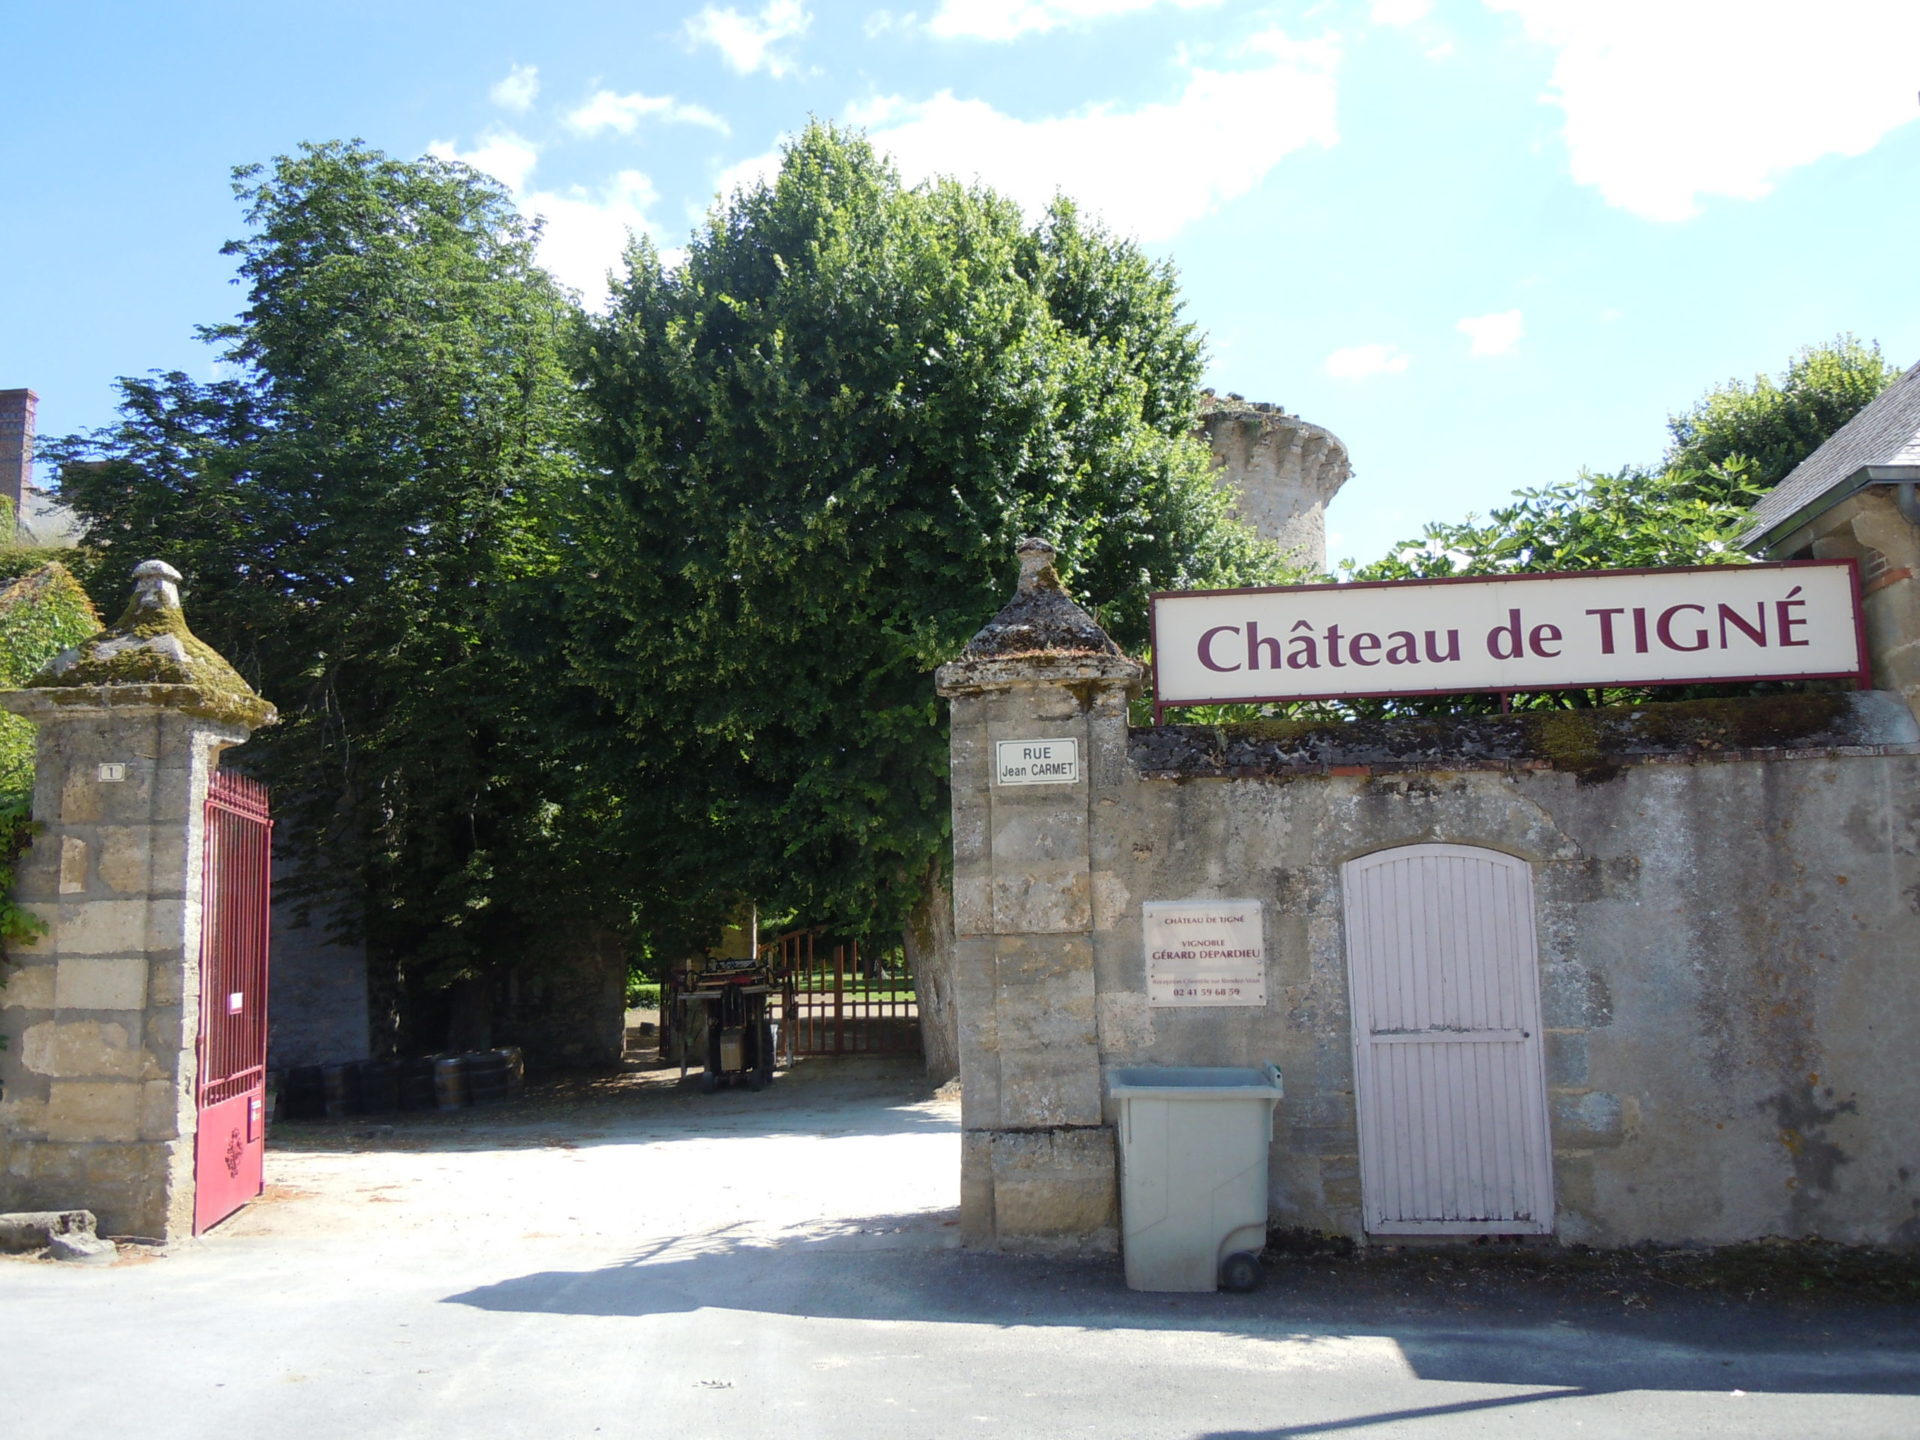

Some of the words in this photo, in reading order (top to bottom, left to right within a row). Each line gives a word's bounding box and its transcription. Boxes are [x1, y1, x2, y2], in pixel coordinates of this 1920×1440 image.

[1197, 619, 1461, 673] Château
[1486, 608, 1563, 660] de
[1585, 585, 1810, 654] TIGNÉ
[1023, 747, 1052, 760] RUE
[108, 766, 114, 778] 1
[1002, 765, 1027, 777] Jean
[1031, 762, 1073, 776] CARMET
[1219, 915, 1244, 923] TIGNÉ
[1182, 939, 1225, 947] VIGNOBLE
[1152, 949, 1196, 961] GÉRARD
[1199, 949, 1260, 959] DEPARDIEU
[1173, 988, 1184, 997] 02
[1187, 988, 1198, 997] 41
